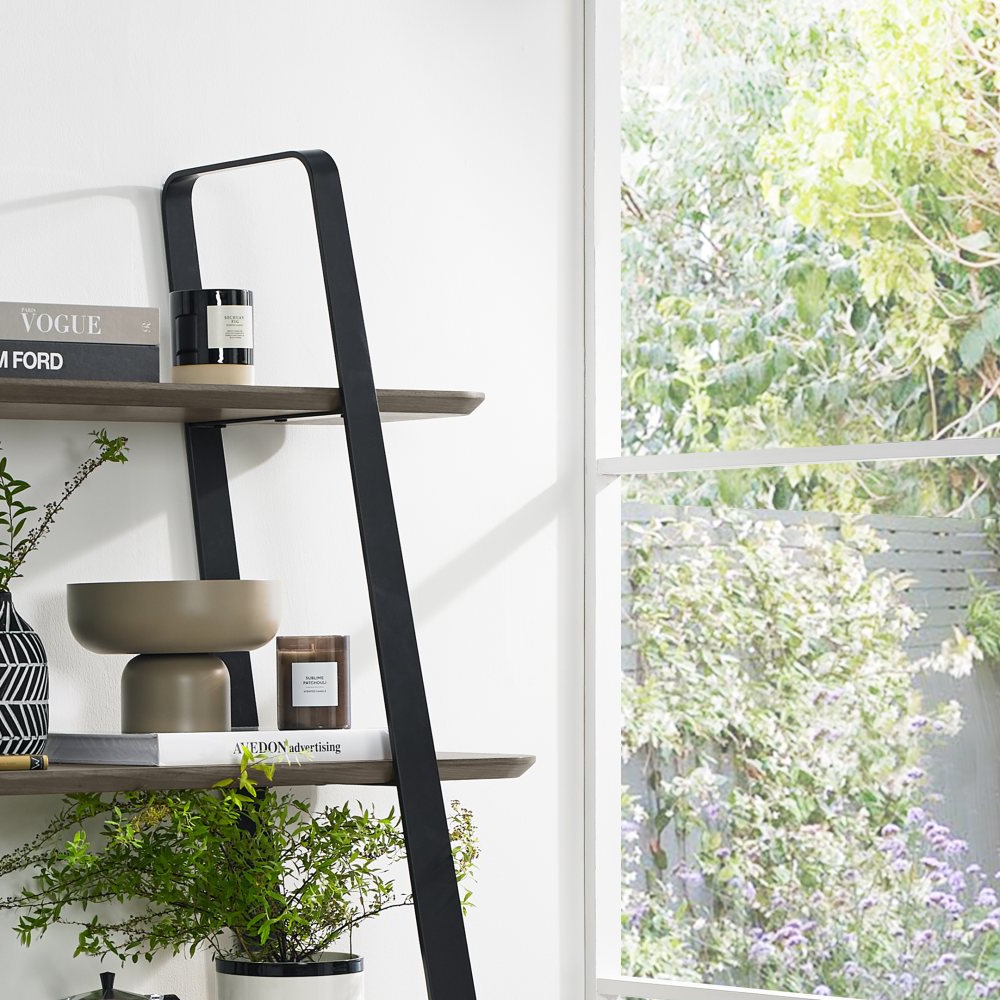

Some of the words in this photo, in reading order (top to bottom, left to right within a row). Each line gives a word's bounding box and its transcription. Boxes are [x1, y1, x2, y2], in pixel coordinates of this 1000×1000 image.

[20, 312, 102, 335] VOGUE
[12, 350, 63, 371] FORD
[289, 741, 342, 754] advertising
